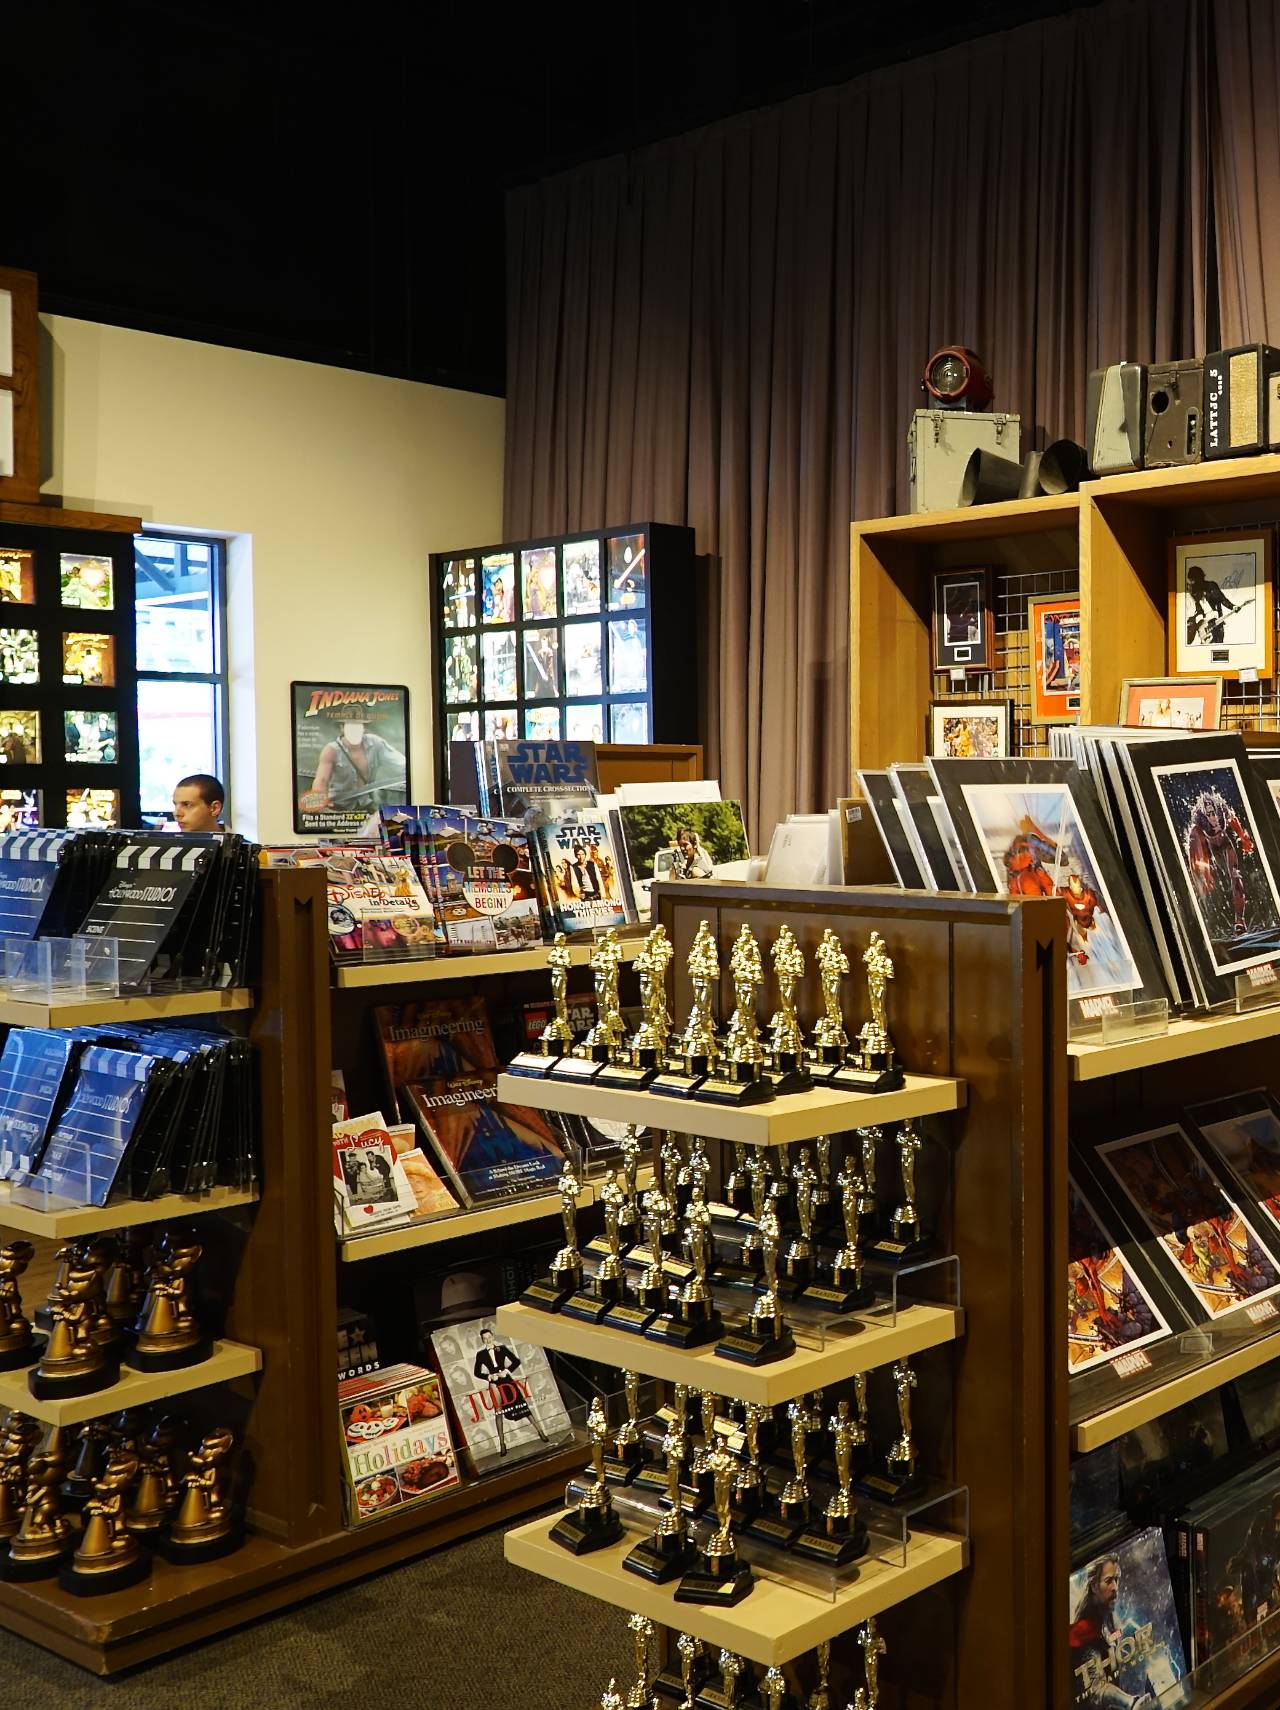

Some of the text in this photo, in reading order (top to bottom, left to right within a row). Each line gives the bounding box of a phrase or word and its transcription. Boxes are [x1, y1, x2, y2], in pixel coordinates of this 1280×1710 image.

[305, 690, 400, 717] INDIANA JONES
[507, 743, 586, 763] STAR
[508, 763, 588, 784] WARS
[556, 825, 600, 838] STAR
[557, 836, 602, 850] WARS
[467, 866, 506, 879] LET THE
[141, 887, 177, 902] STUDIOS
[464, 881, 512, 894] MEMORIES
[475, 897, 507, 909] BEGIN!
[560, 898, 622, 912] HONOR AMONG
[389, 1017, 486, 1042] Imagineering
[569, 1019, 595, 1032] ARS
[421, 1083, 498, 1108] Imagineer
[346, 1134, 385, 1152] Lucy
[337, 1361, 380, 1381] WORDS
[465, 1376, 532, 1423] JUDY
[351, 1431, 448, 1476] Holidays
[1074, 1622, 1154, 1690] THOR
